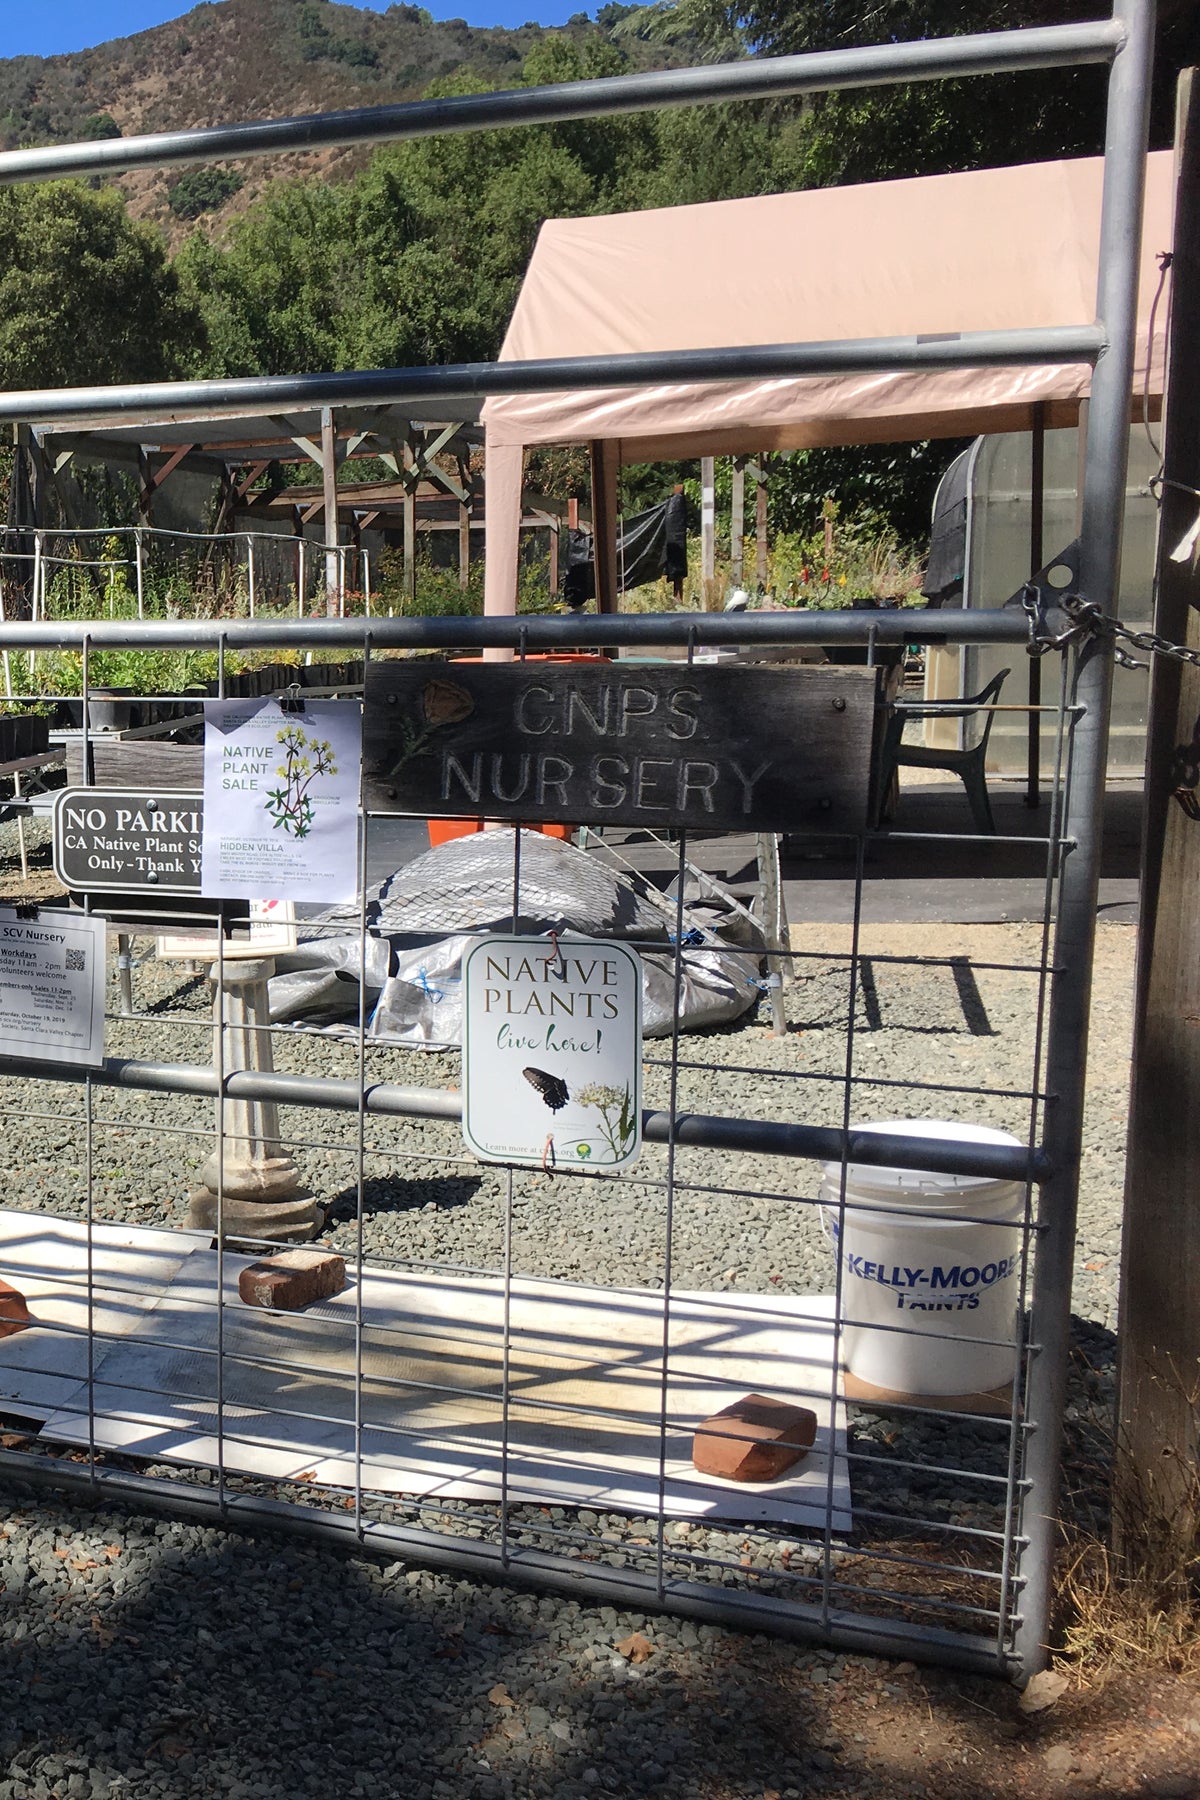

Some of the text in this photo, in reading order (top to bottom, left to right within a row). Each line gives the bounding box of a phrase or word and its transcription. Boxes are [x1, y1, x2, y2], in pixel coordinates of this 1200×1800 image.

[223, 745, 274, 759] NATIVE
[223, 762, 269, 775] PLANT
[222, 778, 259, 791] SALE
[441, 751, 774, 814] NURSERY
[65, 808, 204, 834] NO PARKI
[65, 835, 88, 850] CA
[93, 836, 141, 852] Native
[145, 837, 184, 853] Plant
[220, 842, 284, 853] HIDDEN VILLA
[190, 858, 203, 874] Y
[3, 927, 23, 938] SCV
[26, 930, 66, 944] Nursery
[0, 948, 37, 960] Workdays
[18, 958, 38, 968] 11am
[44, 961, 61, 972] 2pm
[486, 956, 618, 986] NATIVE
[36, 970, 67, 980] welcome
[34, 985, 49, 993] Sales
[484, 988, 619, 1019] PLANTS
[21, 1012, 42, 1021] October
[52, 1016, 66, 1024] 2019
[49, 1028, 64, 1037] Valley
[64, 1030, 85, 1039] Chapter
[497, 1023, 603, 1054] live here!
[485, 1143, 507, 1151] Learn
[848, 1253, 1015, 1289] KELLY-MOORE
